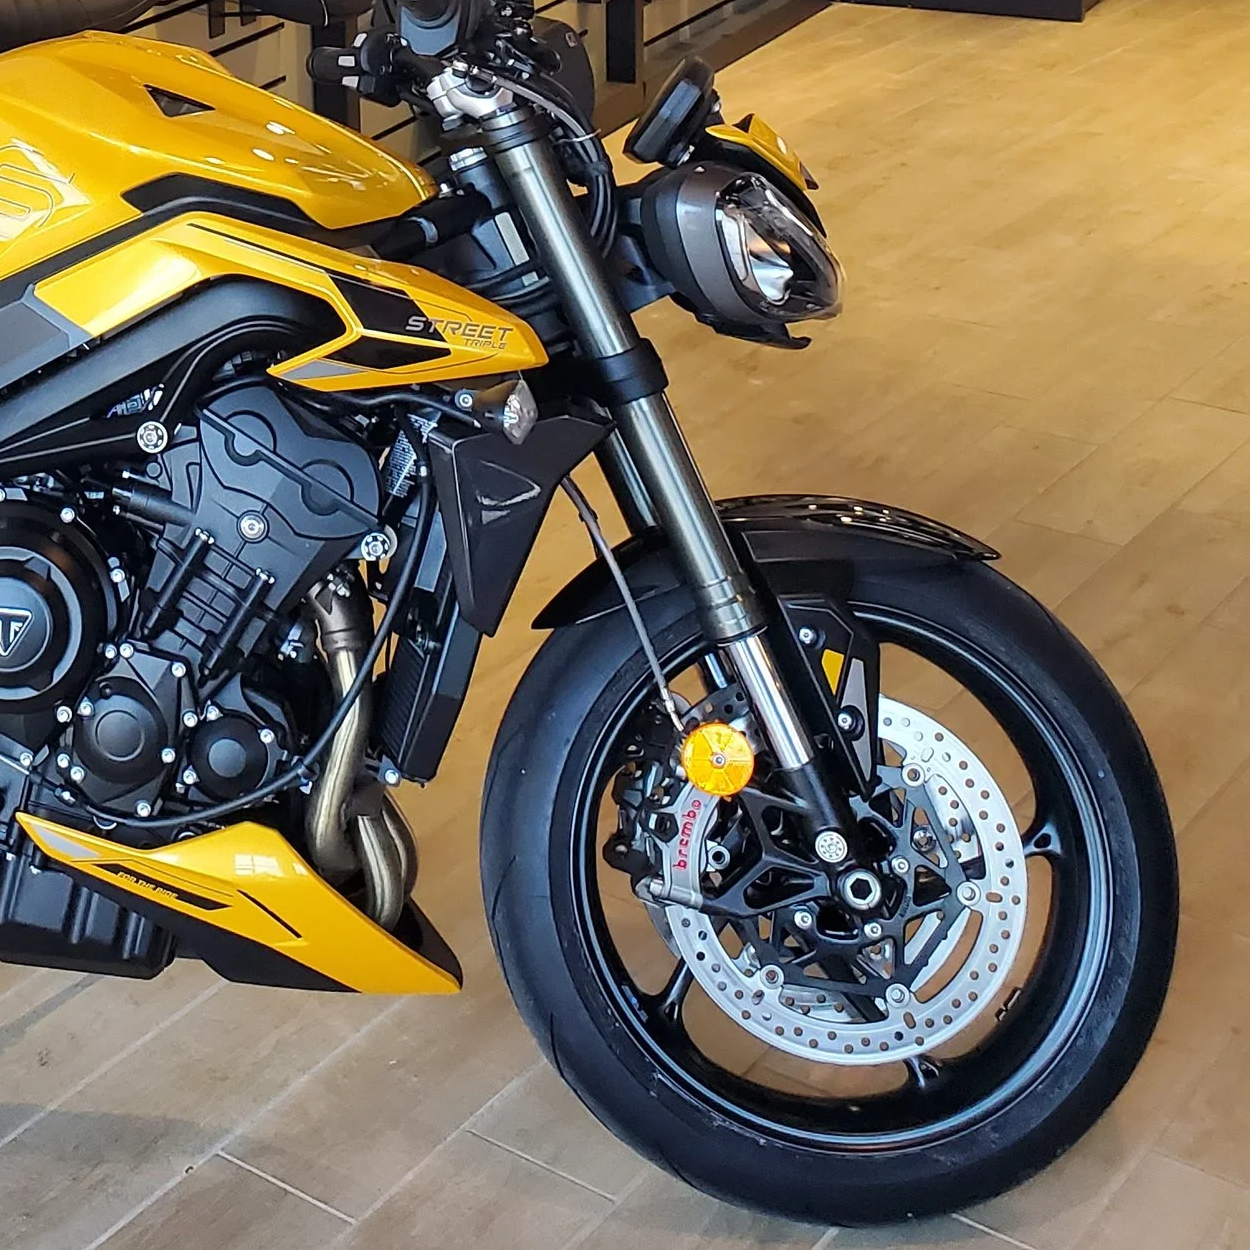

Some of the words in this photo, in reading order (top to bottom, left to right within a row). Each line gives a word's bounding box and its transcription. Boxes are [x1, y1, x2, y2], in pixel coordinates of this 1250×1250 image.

[405, 315, 514, 342] STREET
[464, 338, 507, 350] TRIPLE
[672, 799, 703, 871] brembo
